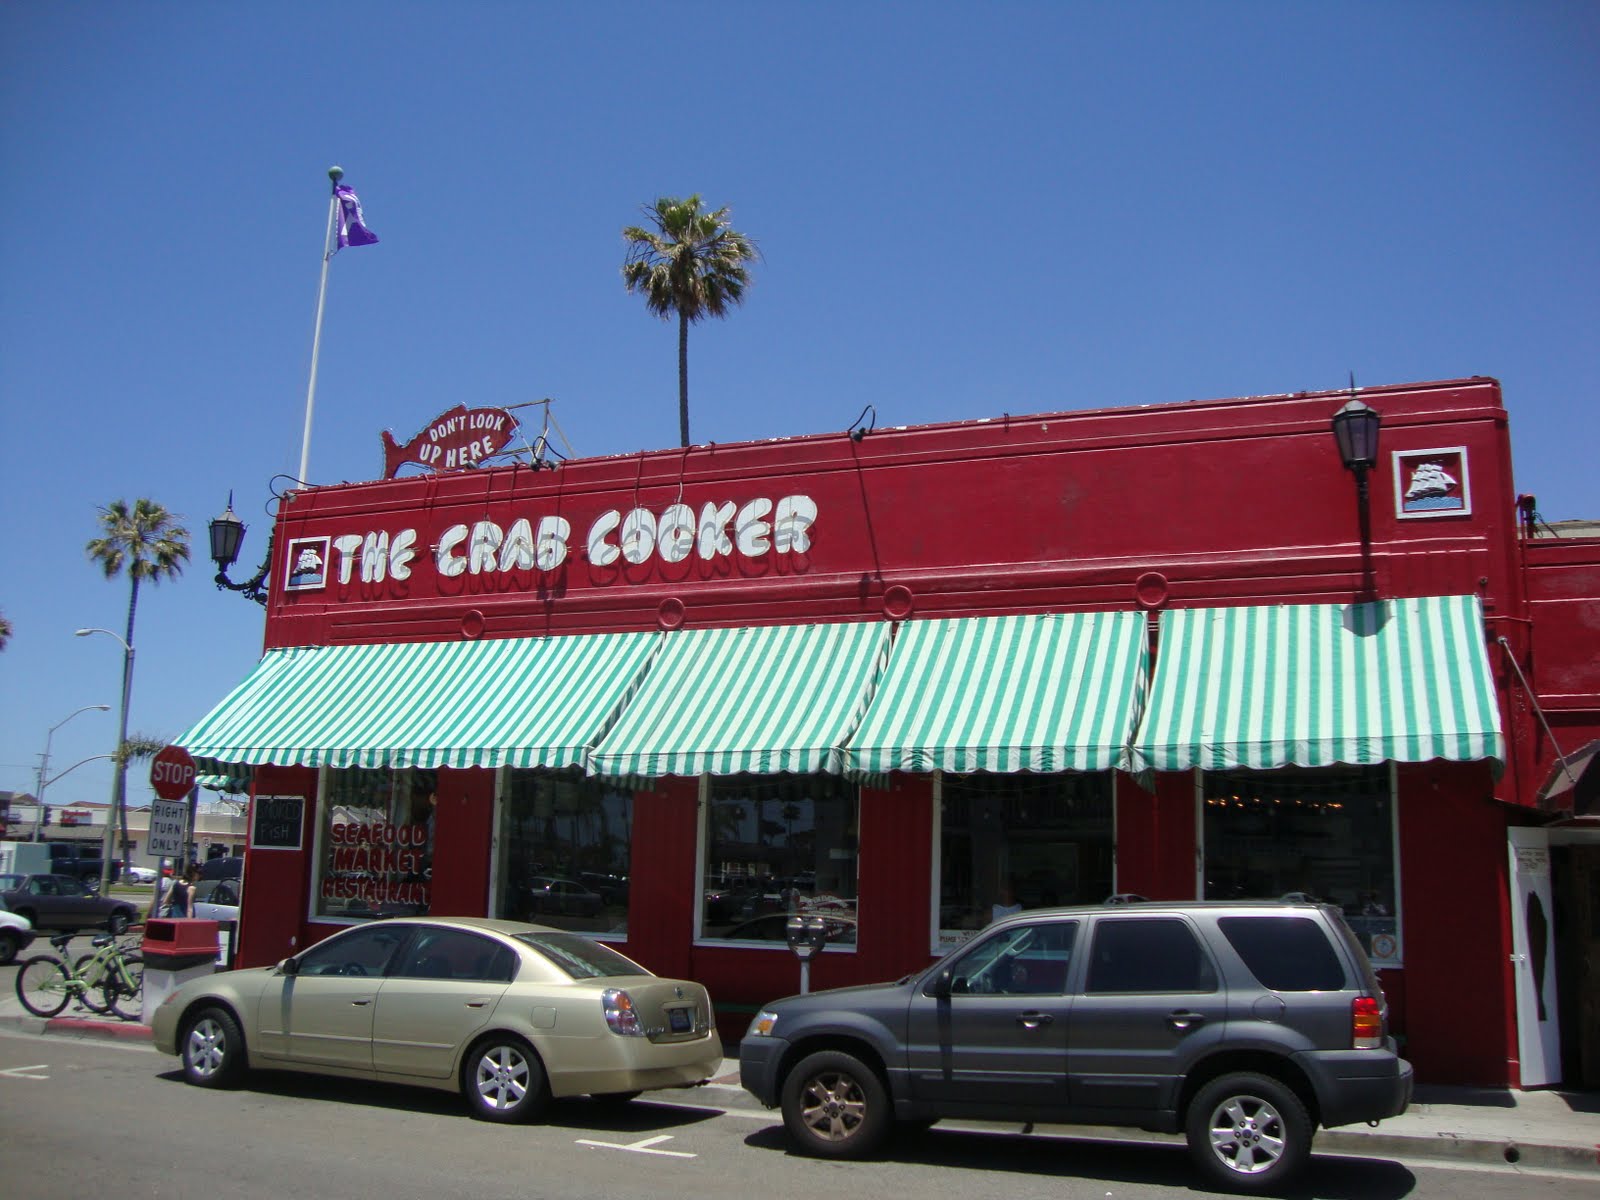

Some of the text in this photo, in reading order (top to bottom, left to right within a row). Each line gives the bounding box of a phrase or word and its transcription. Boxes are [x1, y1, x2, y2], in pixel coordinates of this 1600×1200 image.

[430, 413, 505, 442] DON'T LOOK
[419, 435, 494, 468] UP HERE
[333, 495, 818, 585] THE CRAB COOKER
[153, 760, 194, 785] STOP
[154, 805, 185, 819] RIGHT
[154, 821, 181, 836] TURN
[330, 823, 427, 846] SEAFOOD
[151, 838, 181, 851] ONLY
[332, 847, 424, 875] MARKET
